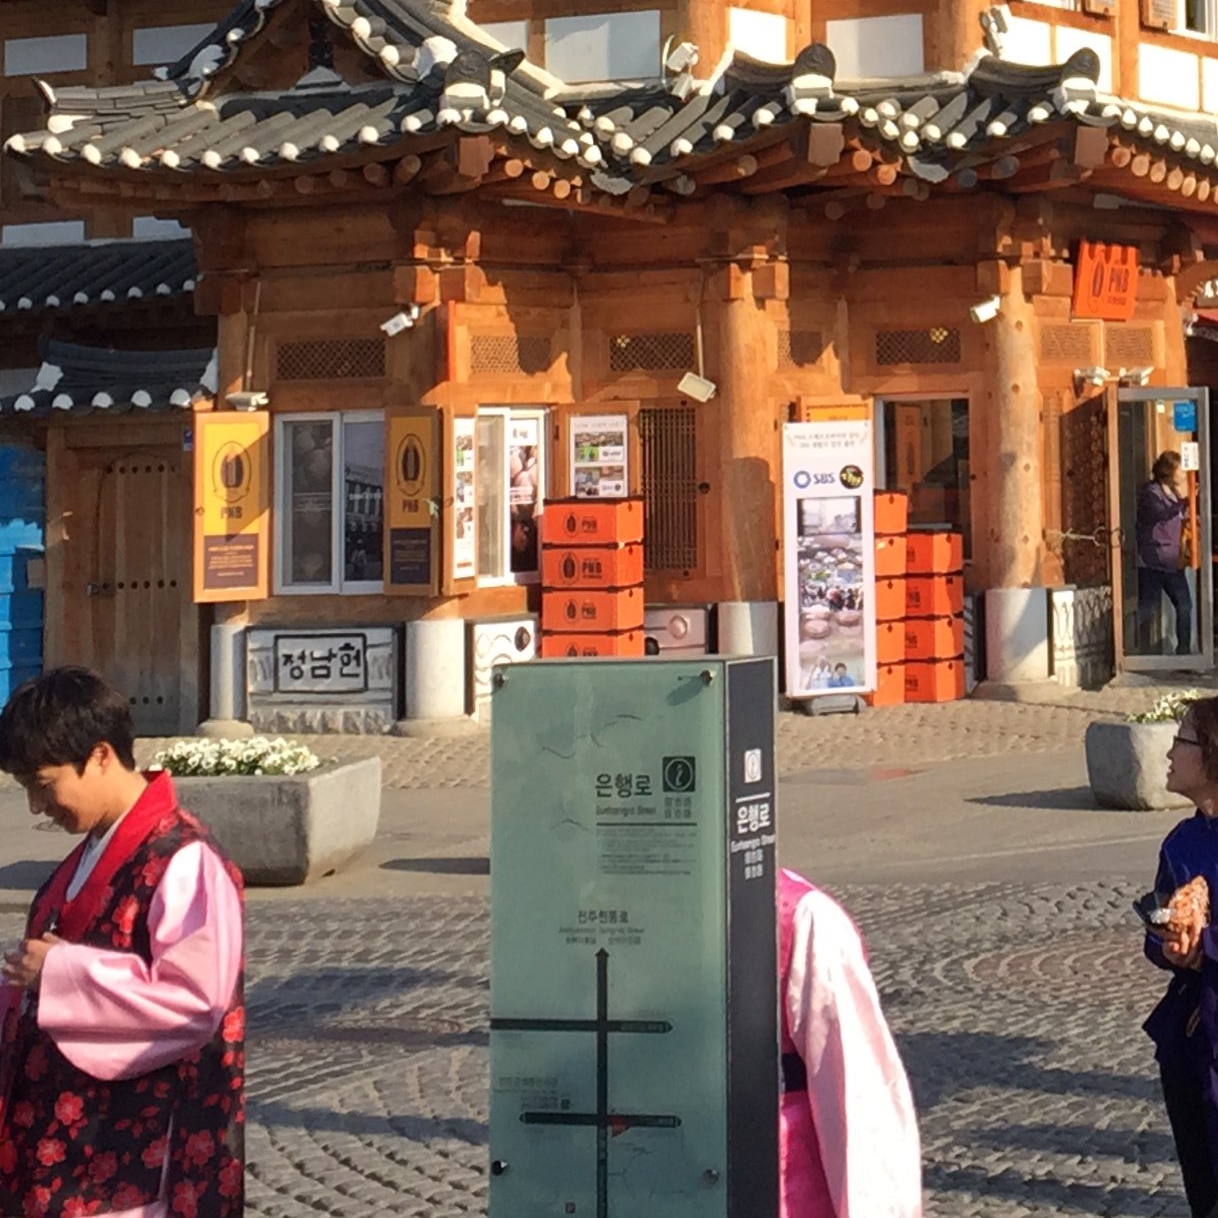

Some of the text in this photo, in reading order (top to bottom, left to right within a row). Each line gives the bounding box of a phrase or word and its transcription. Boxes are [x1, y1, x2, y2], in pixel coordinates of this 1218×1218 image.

[282, 643, 361, 680] 정남헌
[595, 773, 653, 798] 은행로
[737, 803, 771, 833] 은행로
